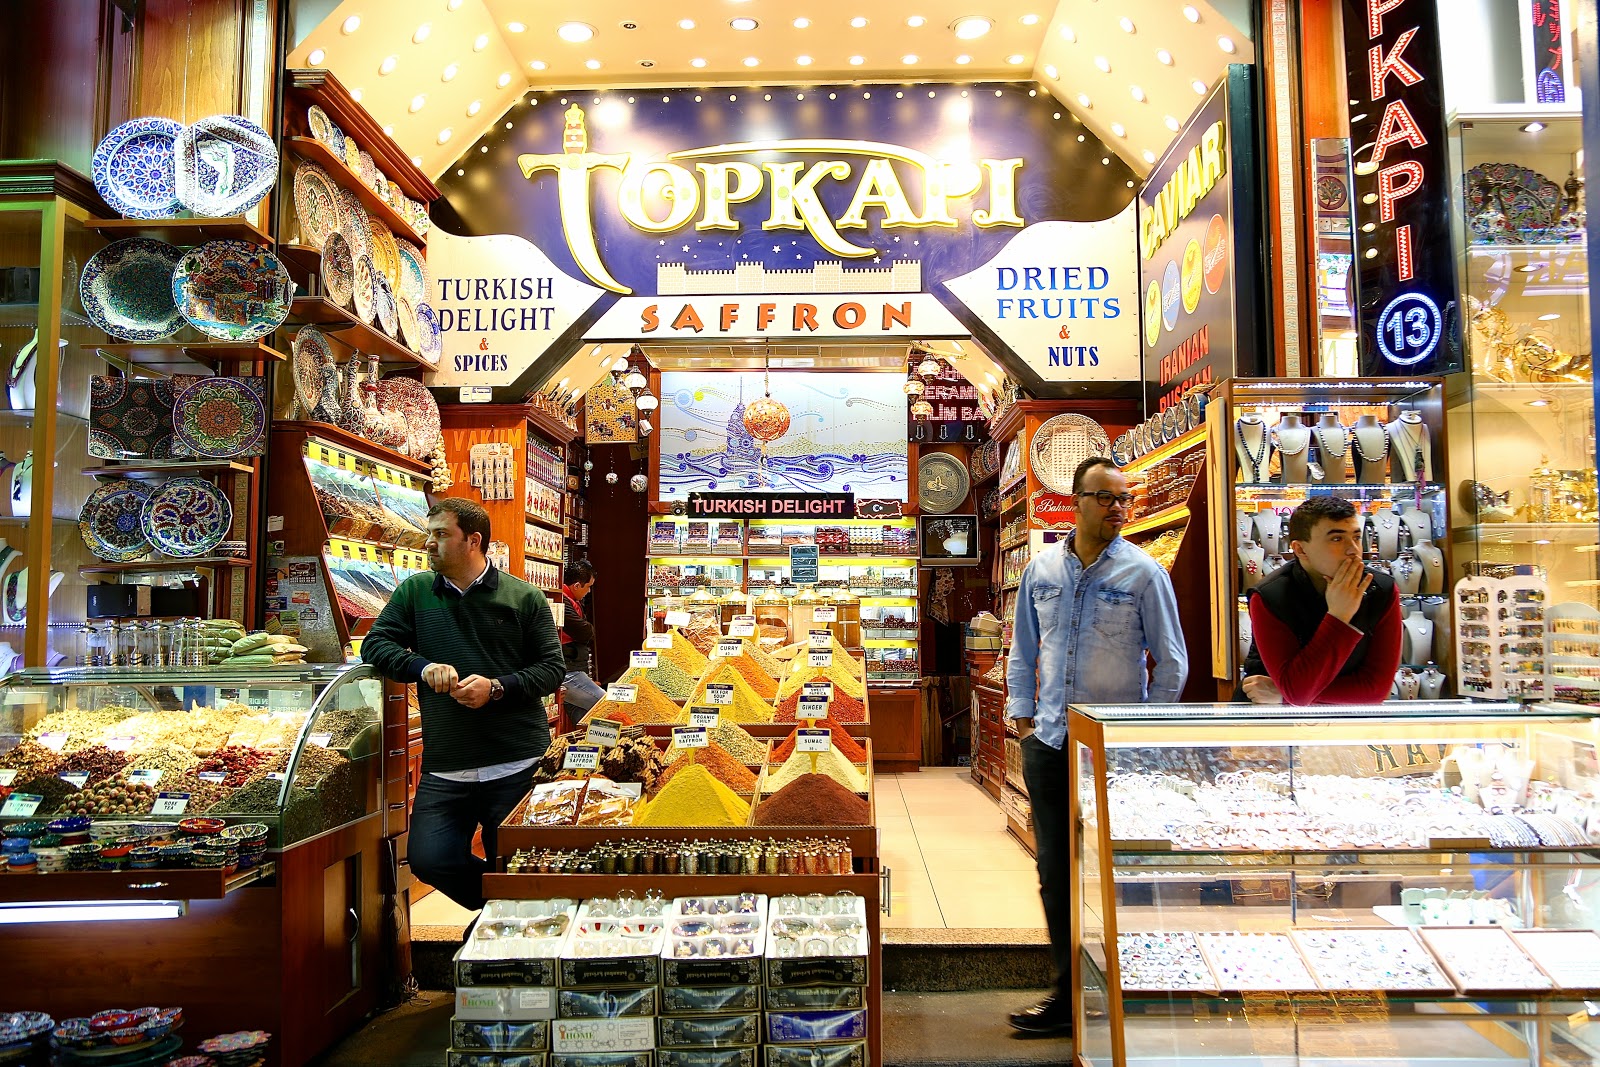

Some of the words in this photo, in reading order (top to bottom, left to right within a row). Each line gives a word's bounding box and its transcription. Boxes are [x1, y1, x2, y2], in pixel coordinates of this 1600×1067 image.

[517, 103, 1025, 296] TOPKAPI
[1140, 121, 1227, 260] CAVIAR
[438, 277, 554, 301] TURKISH
[997, 267, 1109, 290] DRIED
[641, 302, 912, 332] SAFFRON
[997, 298, 1121, 319] FRUITS
[438, 307, 555, 332] DELIGHT
[1386, 307, 1428, 351] 13
[1059, 324, 1070, 339] &
[479, 337, 489, 351] &
[454, 354, 508, 372] SPICES
[1048, 346, 1099, 367] NUTS
[1160, 324, 1209, 387] IRANIAN
[923, 385, 978, 400] ERAMI
[693, 499, 767, 513] TURKISH
[772, 499, 845, 514] DELIGHT
[589, 729, 617, 739] CINNAMON
[566, 1032, 595, 1040] HOME
